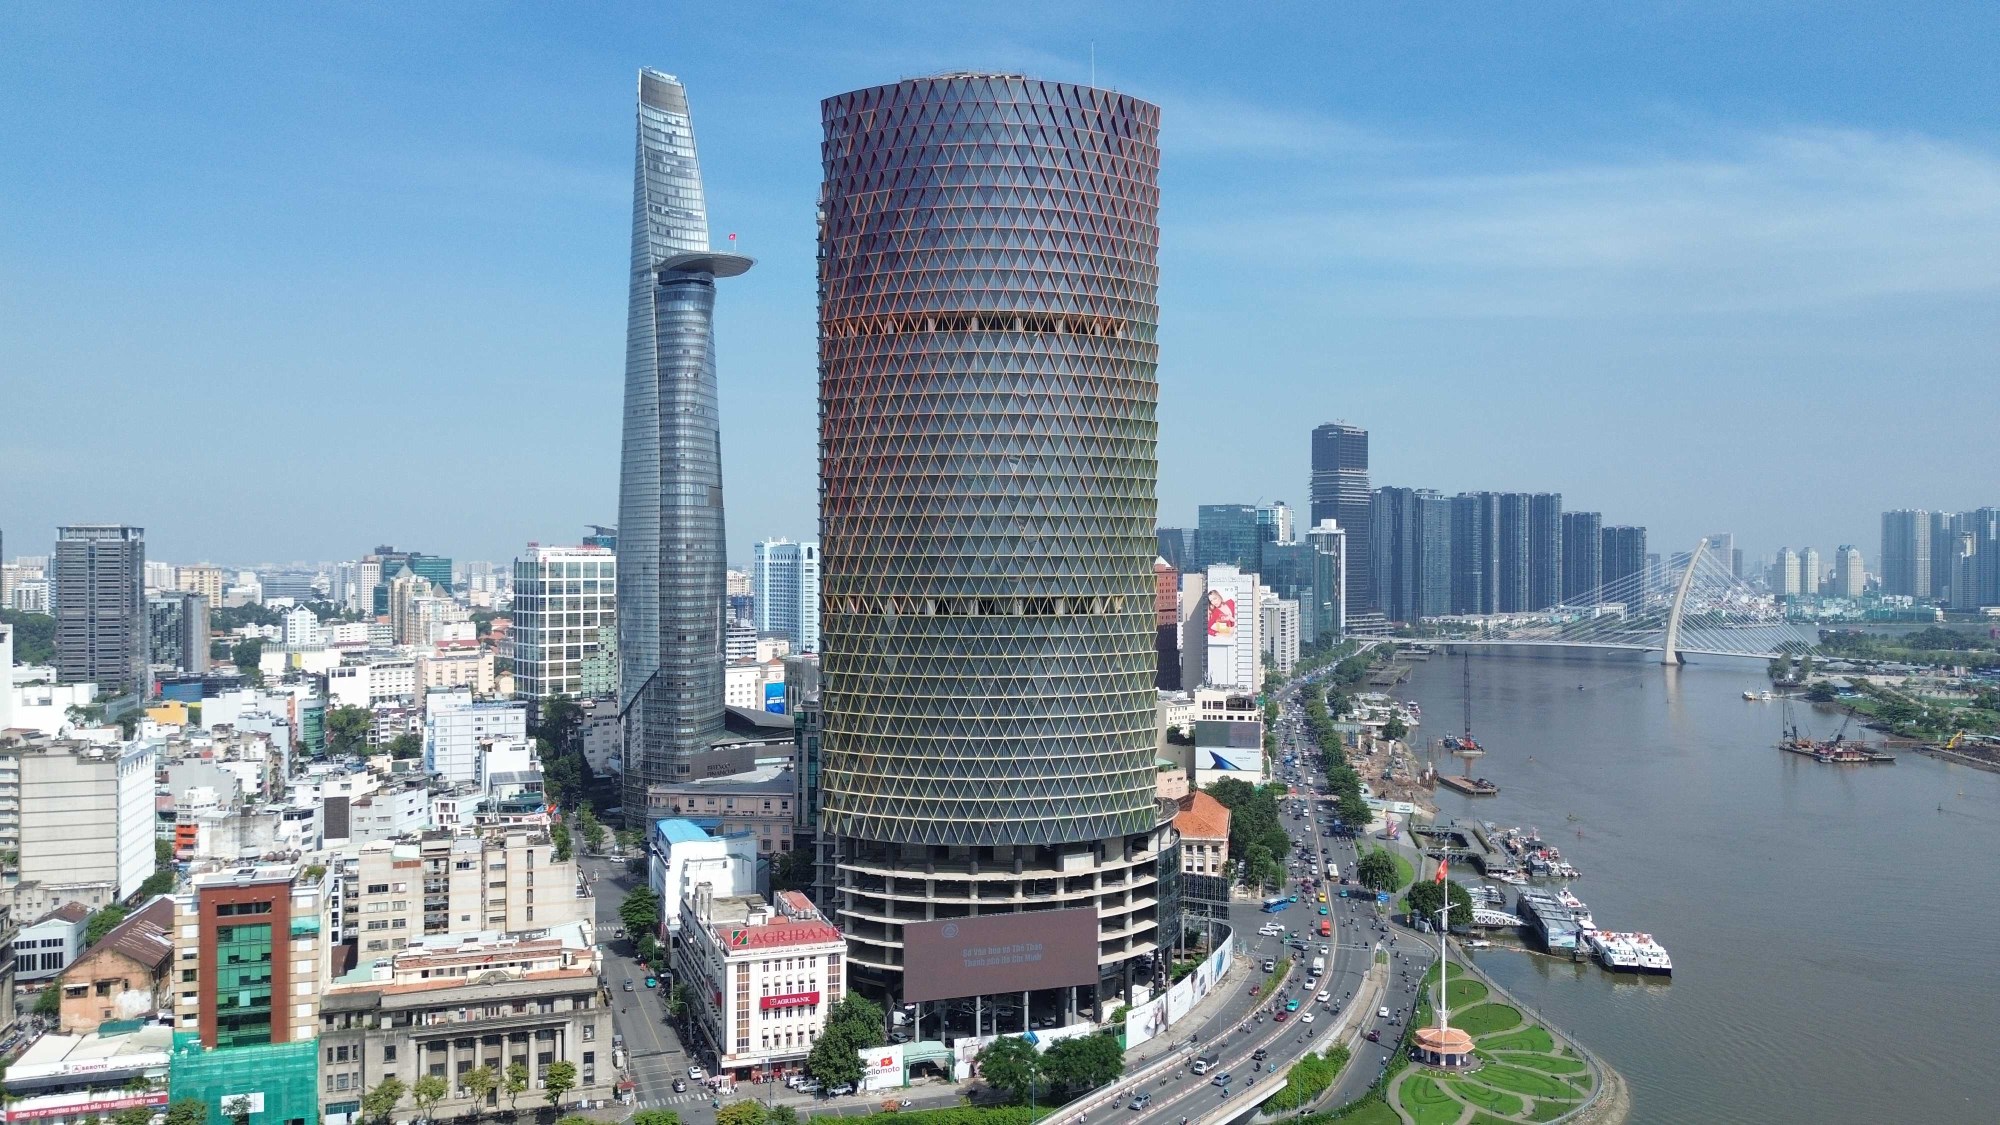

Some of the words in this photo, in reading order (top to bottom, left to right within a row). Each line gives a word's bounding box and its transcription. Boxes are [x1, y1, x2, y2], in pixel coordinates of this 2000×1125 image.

[751, 926, 841, 944] AGRIBANK
[776, 996, 810, 1005] AGRIBANK
[865, 1066, 900, 1076] ellomoto
